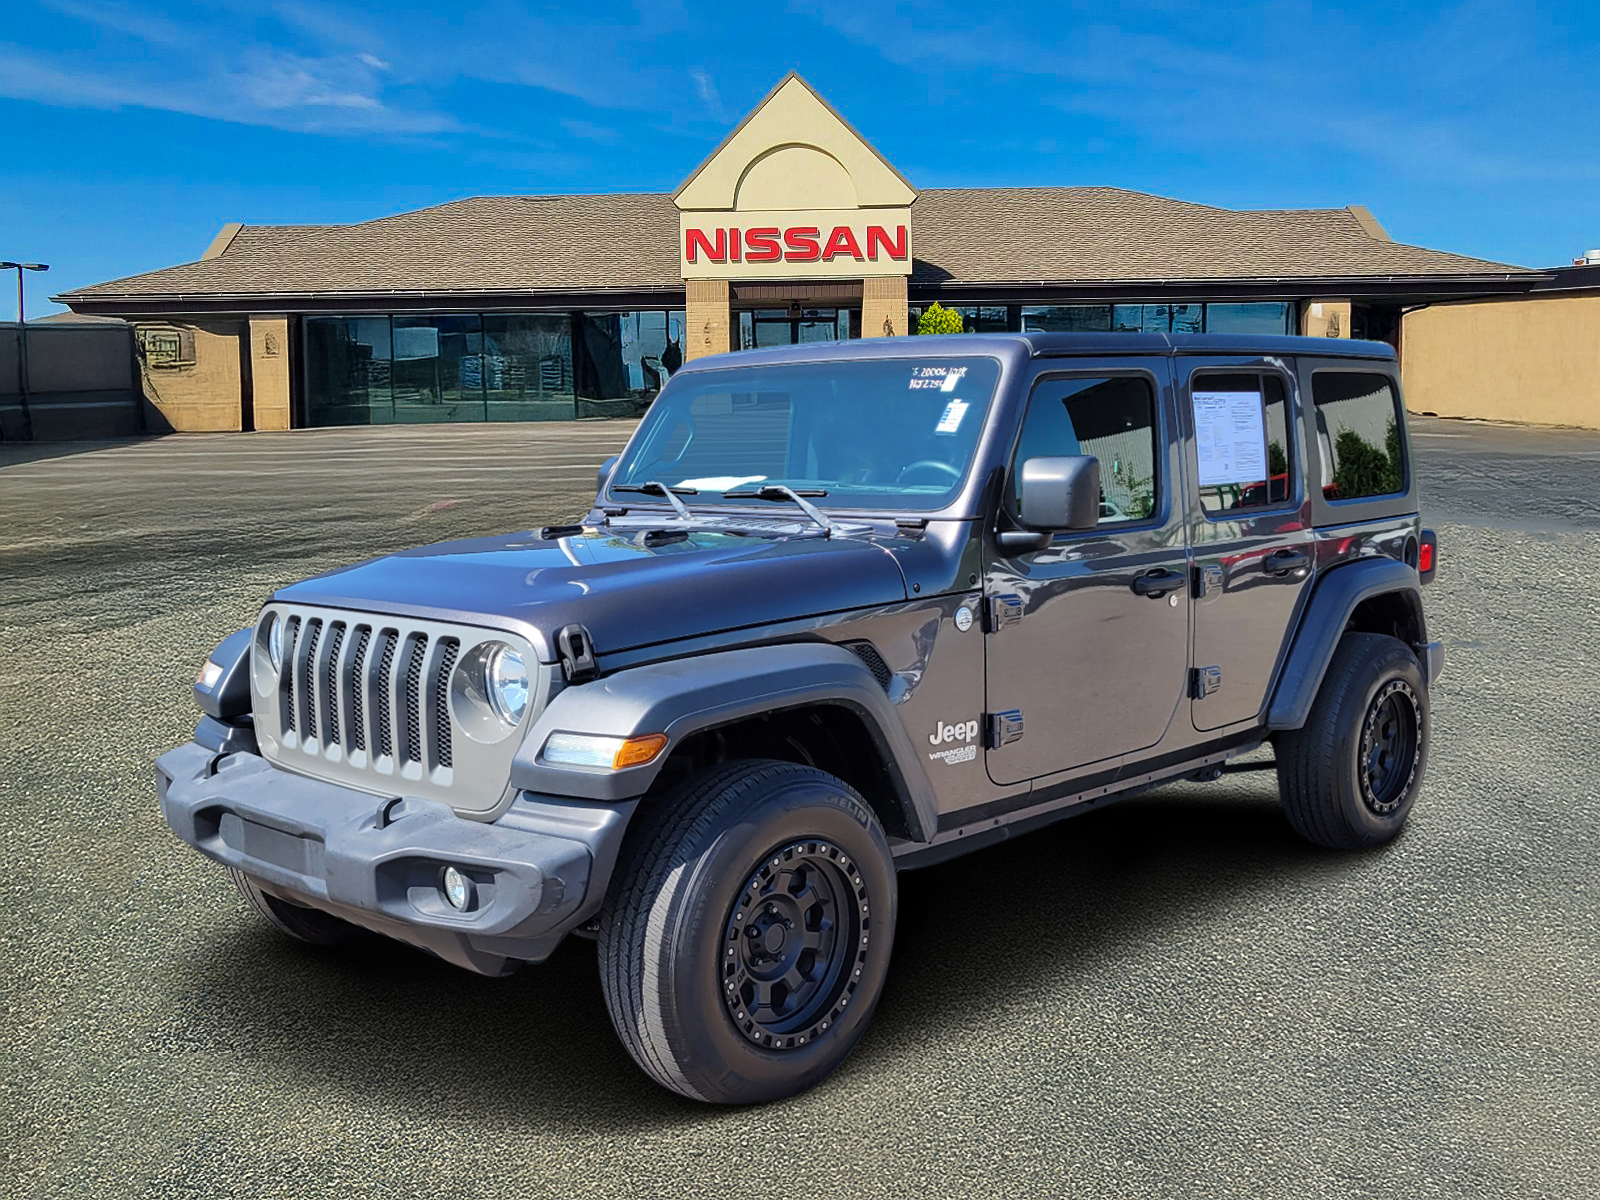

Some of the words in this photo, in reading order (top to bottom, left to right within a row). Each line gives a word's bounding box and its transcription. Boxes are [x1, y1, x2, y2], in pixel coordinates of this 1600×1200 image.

[685, 225, 908, 264] NISSAN
[929, 720, 978, 745] Jeep
[928, 745, 976, 760] WRANGLER
